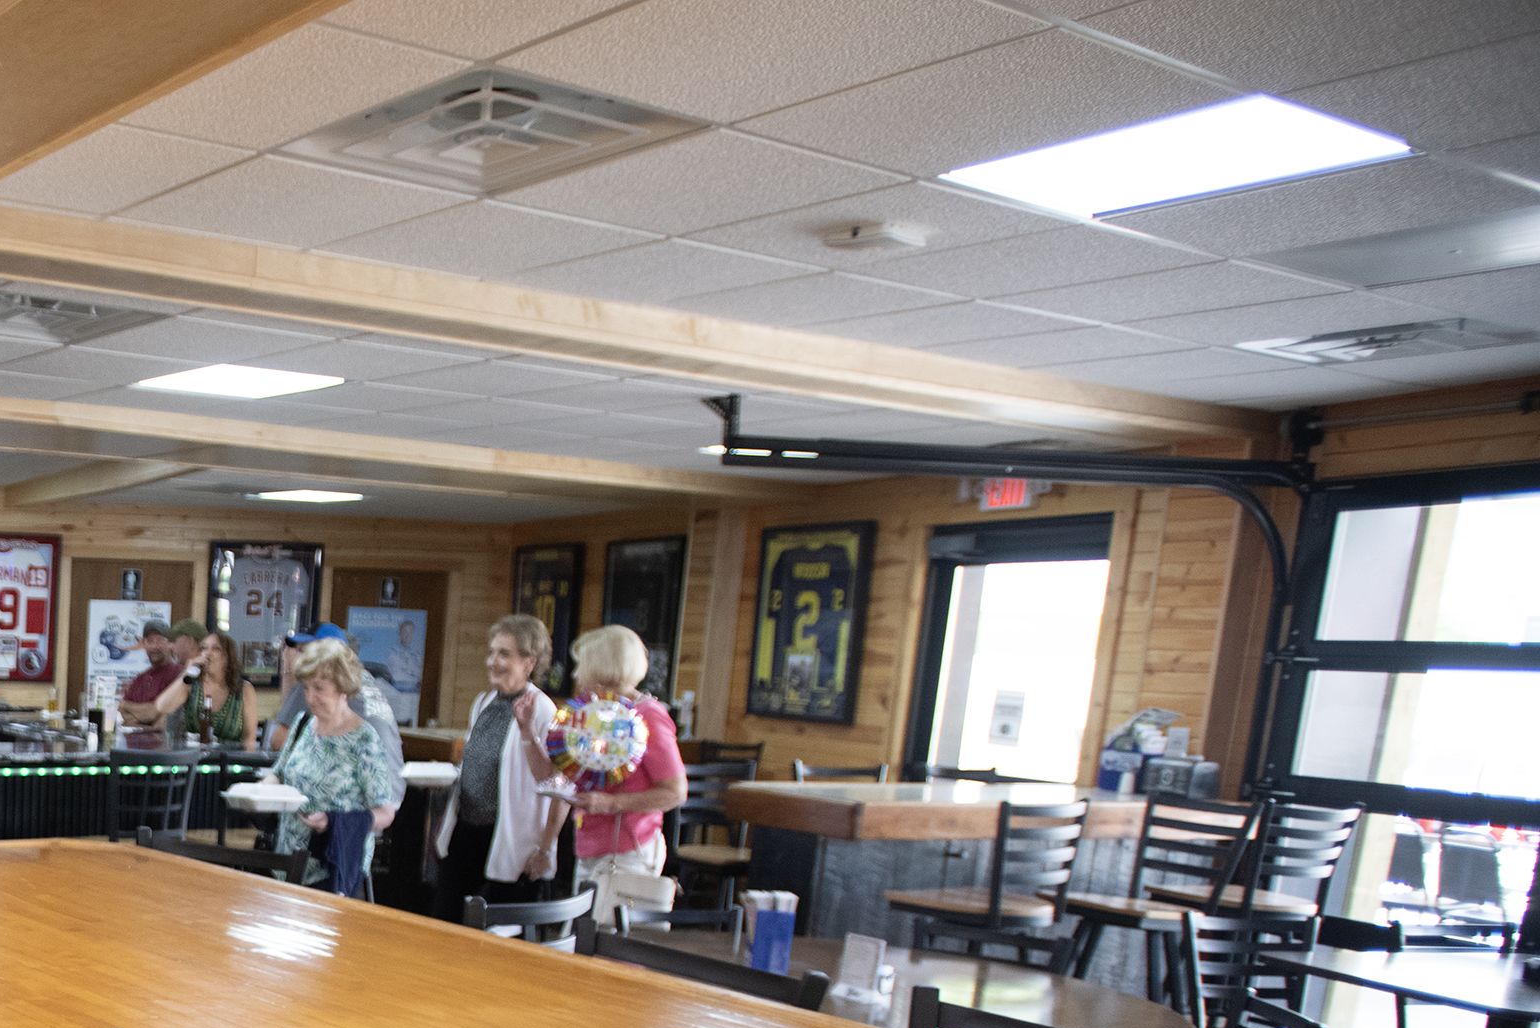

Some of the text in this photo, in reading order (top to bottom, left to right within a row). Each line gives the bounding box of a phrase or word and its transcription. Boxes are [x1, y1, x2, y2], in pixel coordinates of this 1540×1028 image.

[986, 478, 1026, 507] EXIT
[28, 566, 48, 587] 19
[243, 569, 290, 586] CABRERA
[245, 588, 284, 617] 24
[793, 589, 821, 649] 2
